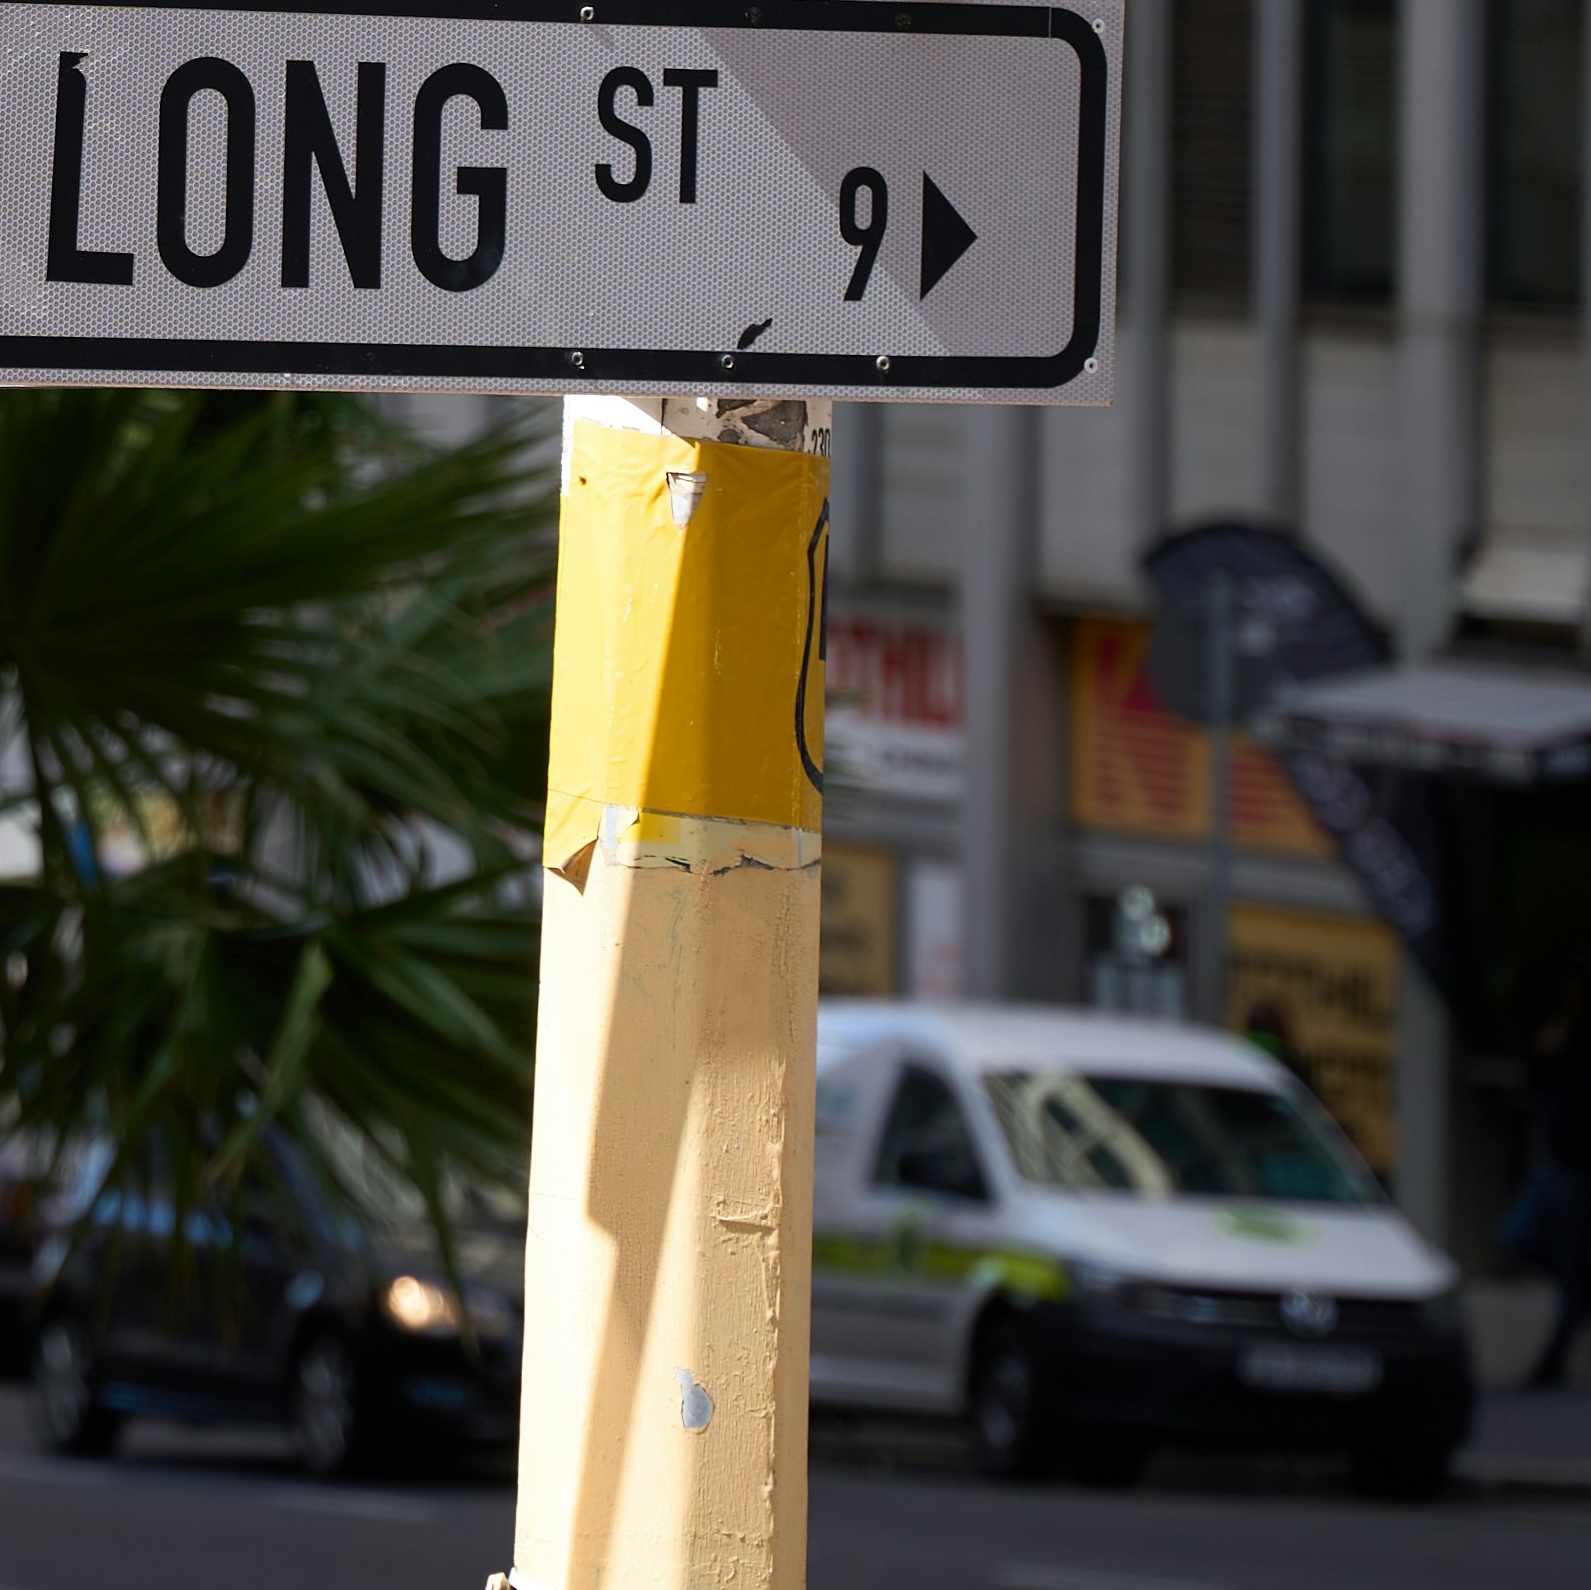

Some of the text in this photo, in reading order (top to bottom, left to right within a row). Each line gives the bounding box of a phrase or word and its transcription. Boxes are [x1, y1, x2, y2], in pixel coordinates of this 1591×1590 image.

[45, 50, 719, 293] LONG ST
[838, 166, 889, 302] 9
